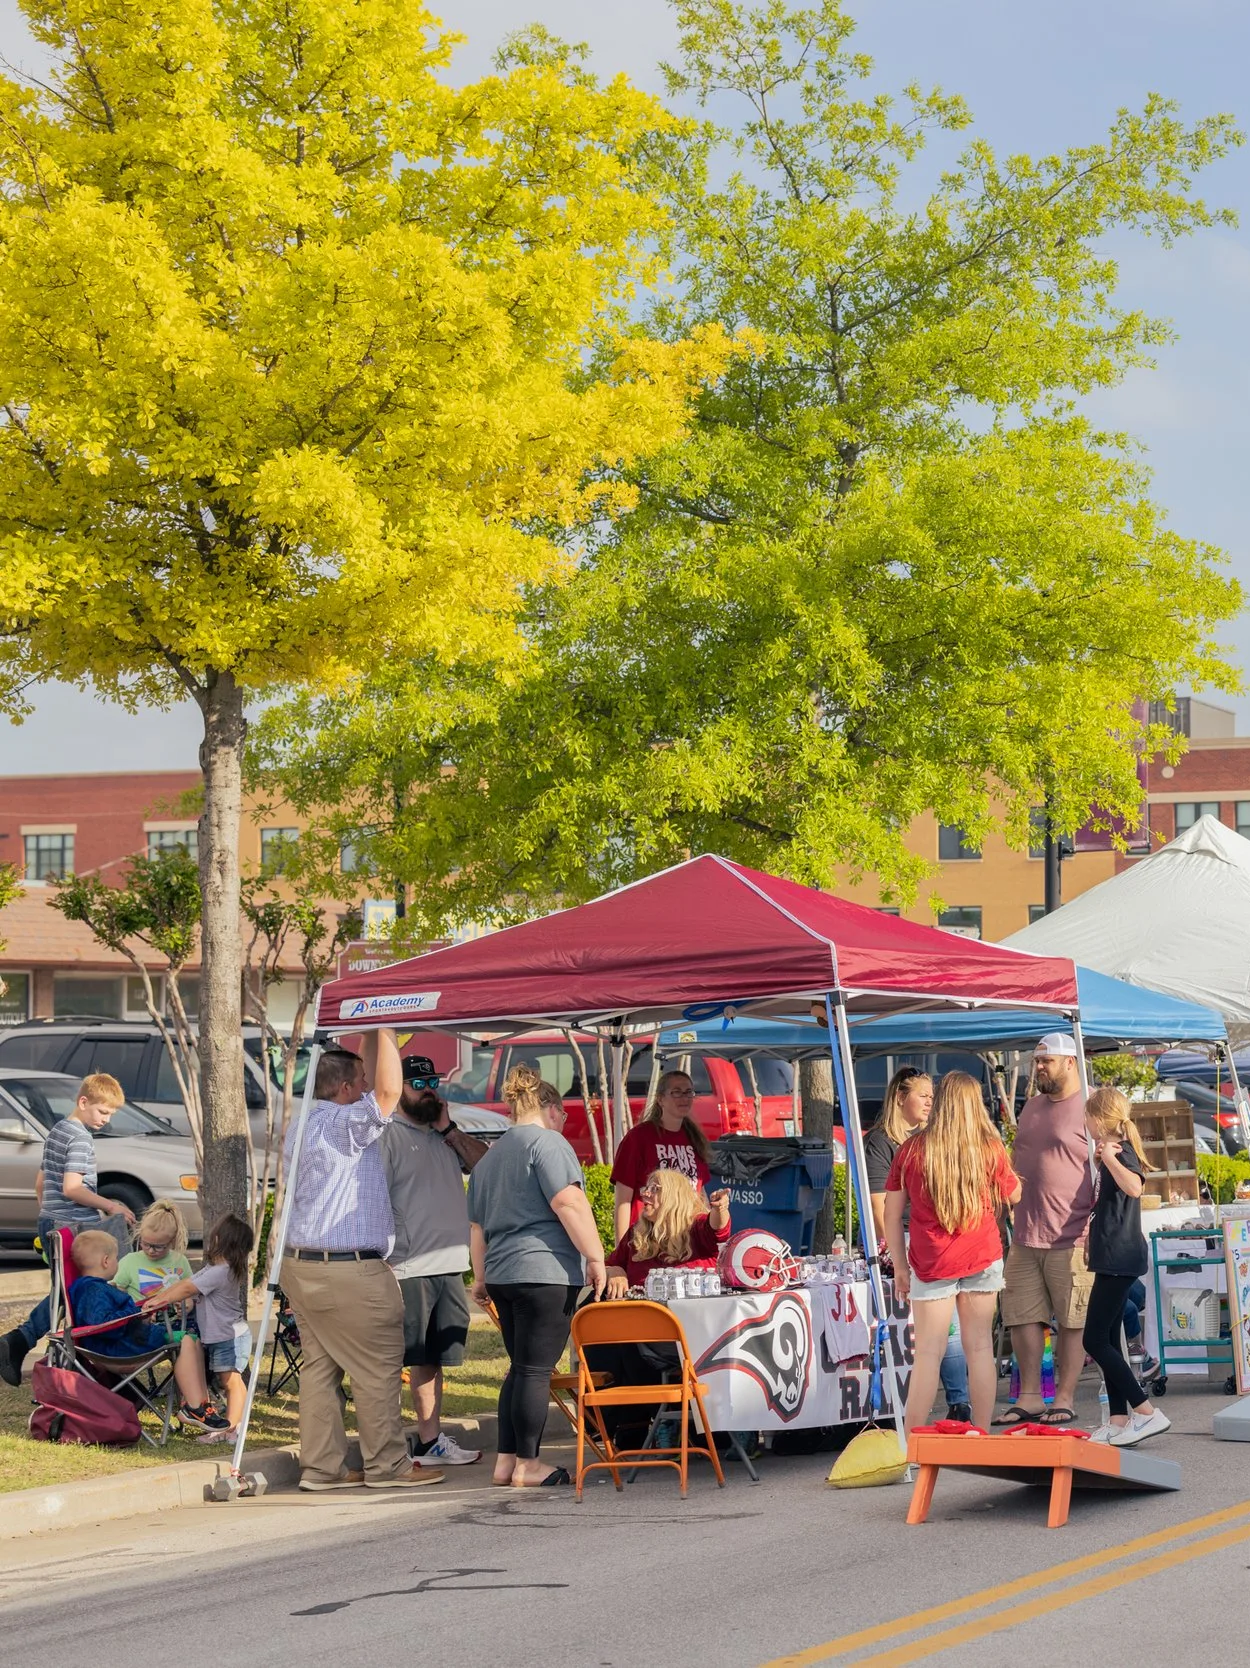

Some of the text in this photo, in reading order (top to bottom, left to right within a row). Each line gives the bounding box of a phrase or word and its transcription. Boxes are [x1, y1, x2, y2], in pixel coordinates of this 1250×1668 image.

[370, 997, 424, 1008] Academy
[656, 1144, 695, 1159] RAMS
[719, 1189, 763, 1205] WASSO
